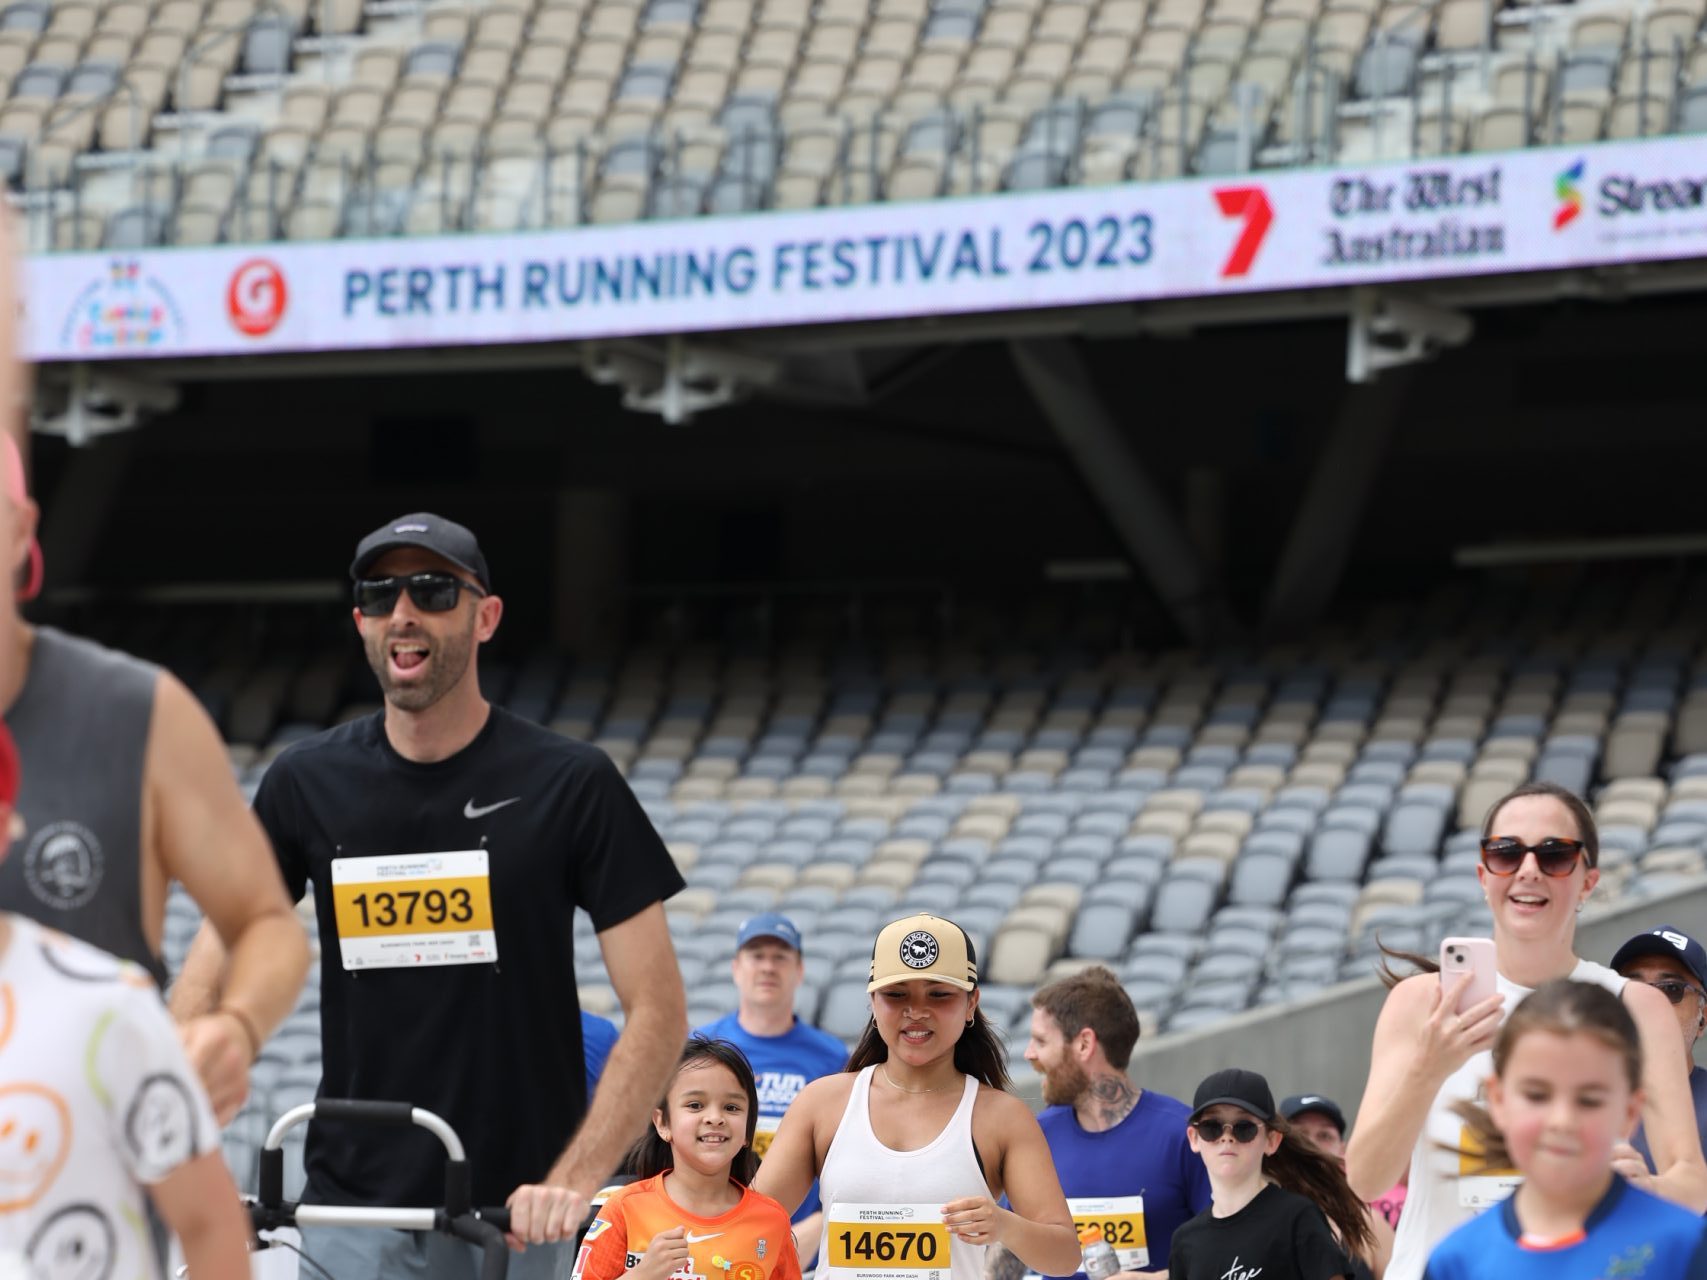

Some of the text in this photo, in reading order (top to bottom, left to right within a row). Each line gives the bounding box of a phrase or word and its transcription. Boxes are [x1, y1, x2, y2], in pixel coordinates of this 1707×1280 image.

[1332, 176, 1397, 216] The
[1599, 175, 1707, 216] Strea
[1321, 221, 1506, 265] Australian
[343, 212, 1154, 316] PERTH RUNNING FESTIVAL 2023
[352, 888, 473, 927] 13793
[839, 1231, 937, 1261] 14670
